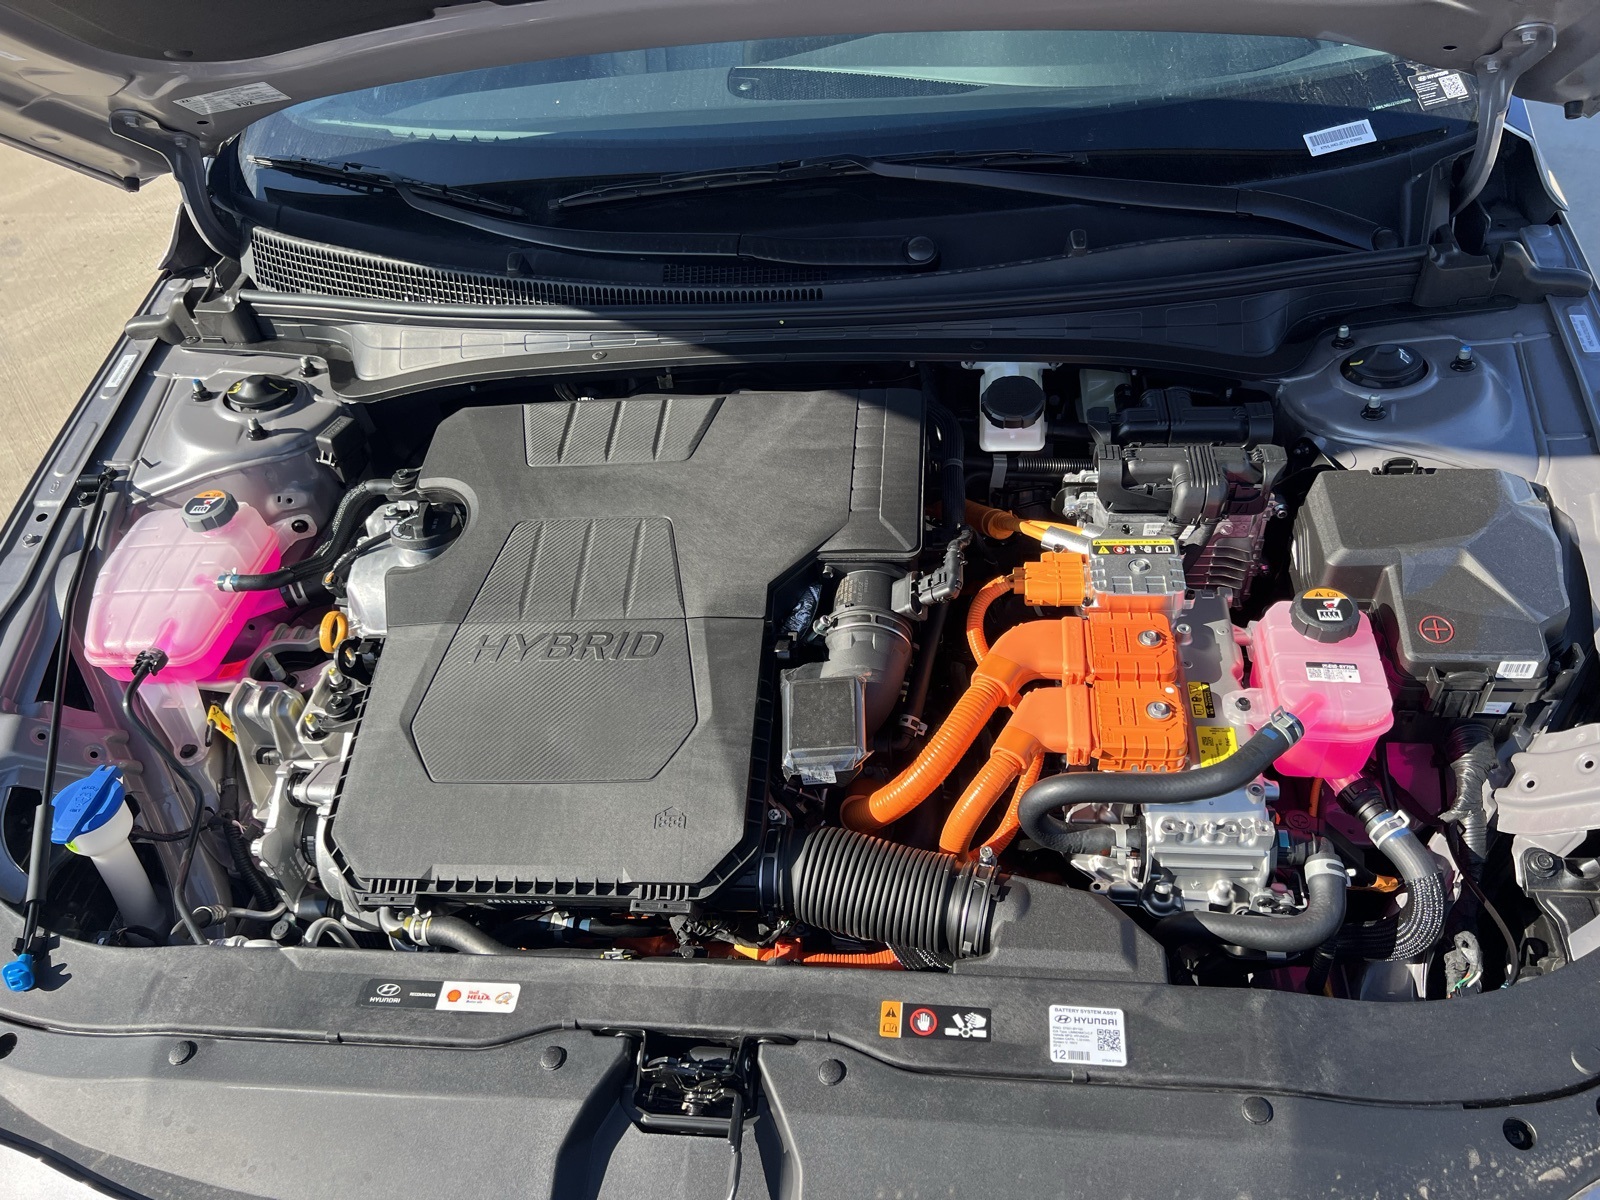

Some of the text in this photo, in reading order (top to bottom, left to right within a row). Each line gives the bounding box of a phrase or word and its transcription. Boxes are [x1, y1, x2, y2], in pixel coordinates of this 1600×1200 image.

[468, 631, 665, 663] HYBRID
[467, 993, 491, 1001] HELIX
[1074, 1016, 1118, 1026] HYUNDAI
[1053, 1049, 1066, 1060] 12
